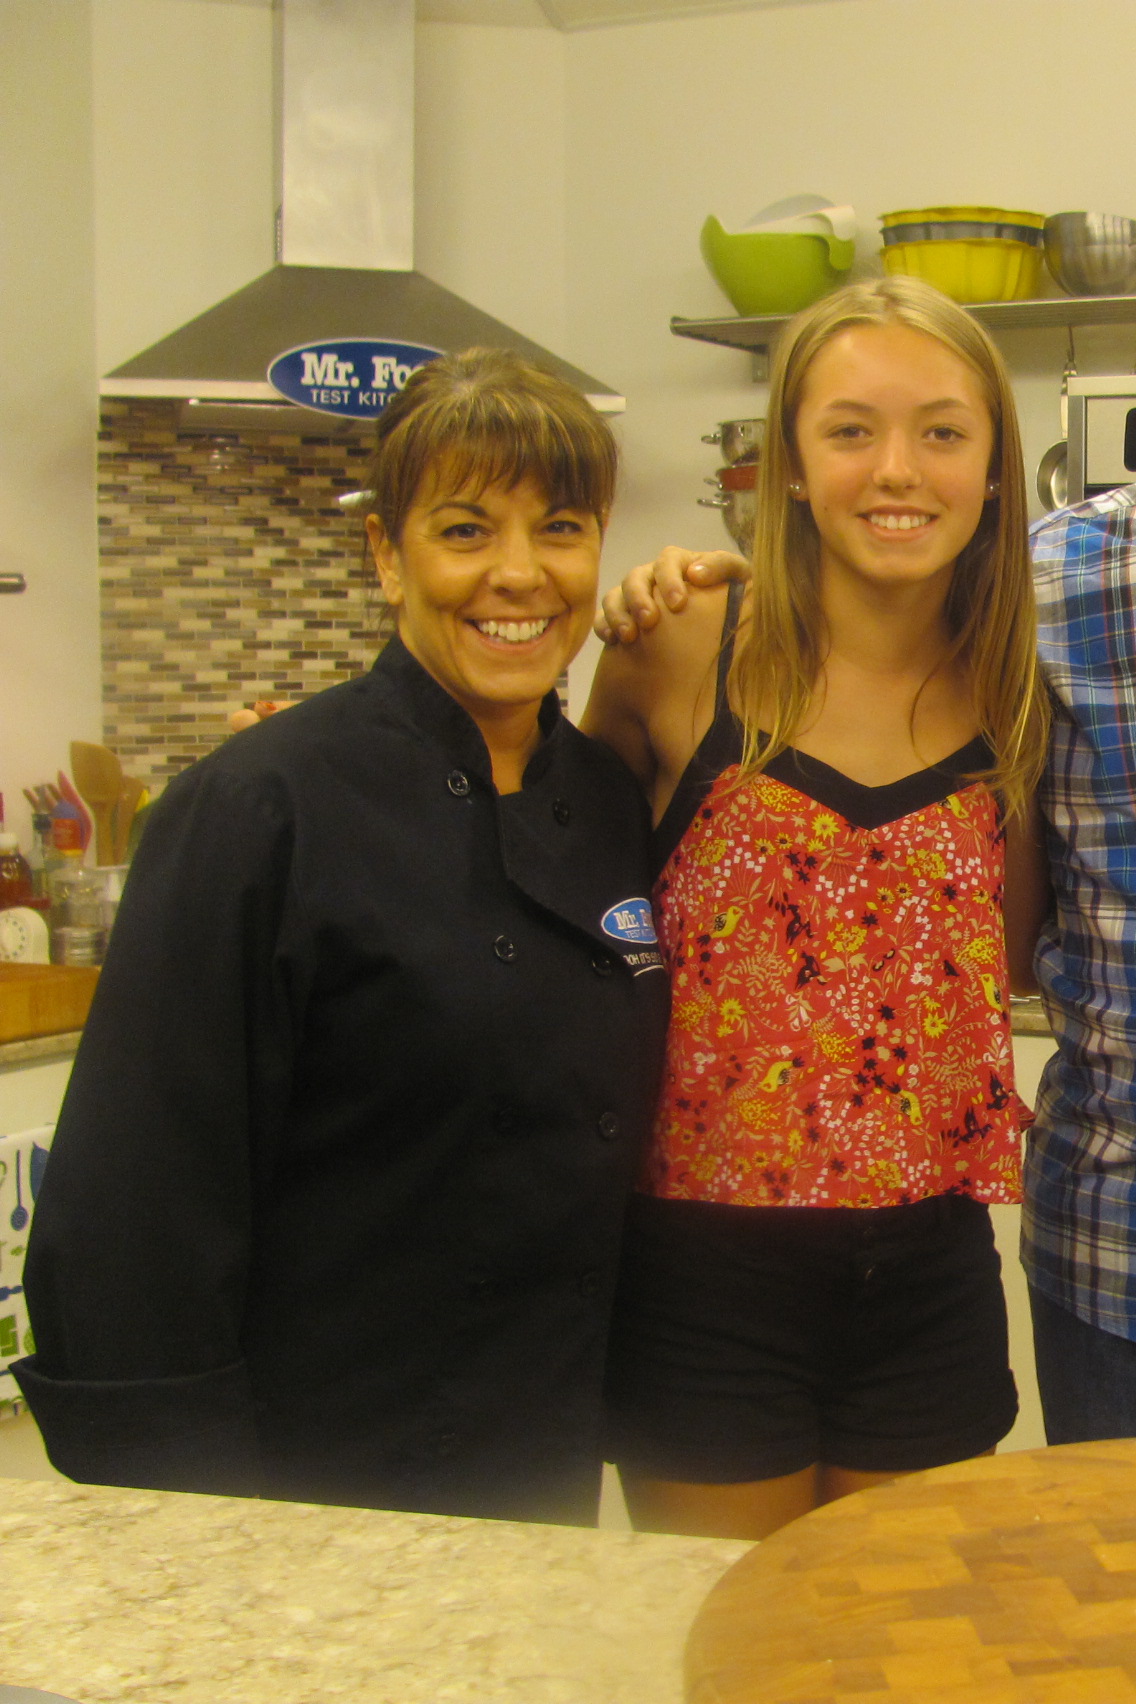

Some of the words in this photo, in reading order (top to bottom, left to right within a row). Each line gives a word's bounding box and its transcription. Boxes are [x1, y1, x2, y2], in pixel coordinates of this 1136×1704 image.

[301, 353, 360, 388] Mr.
[371, 356, 424, 390] Fo
[310, 389, 351, 404] TEST
[614, 910, 639, 929] Mr.
